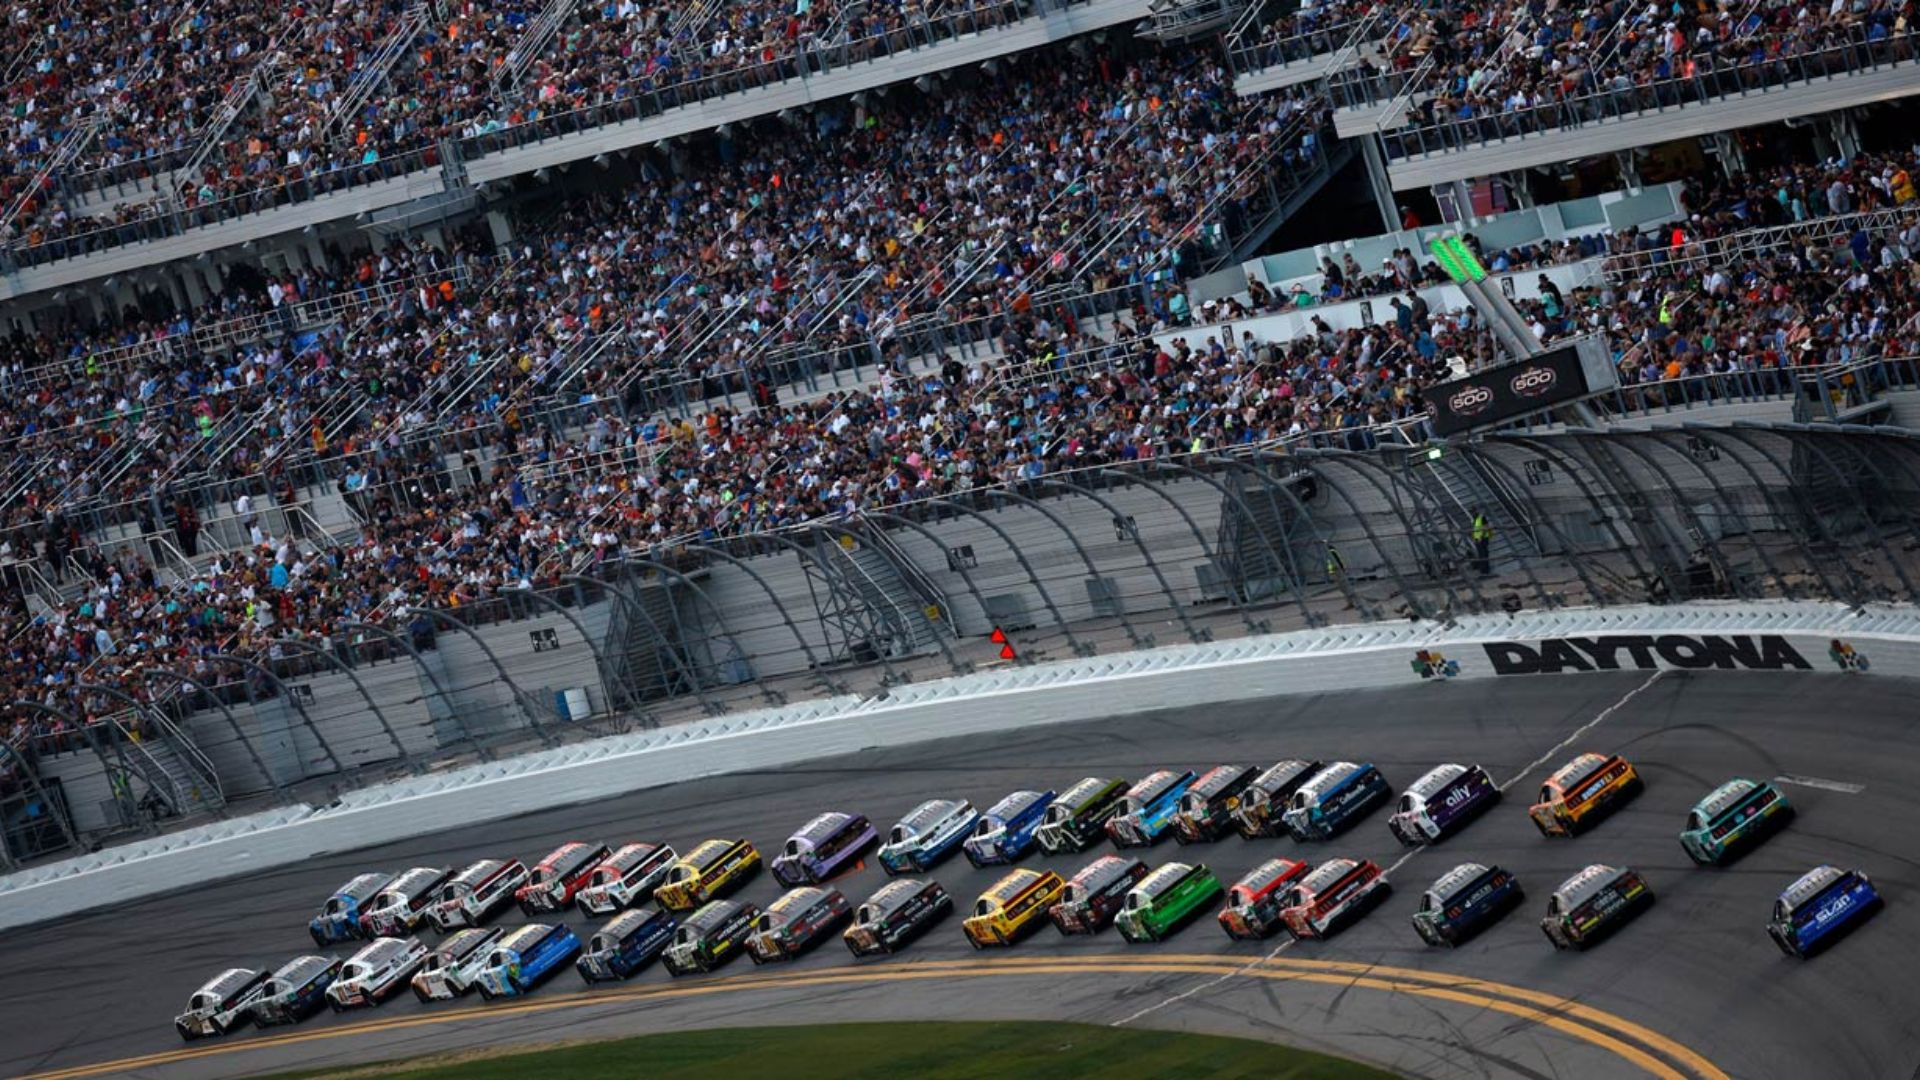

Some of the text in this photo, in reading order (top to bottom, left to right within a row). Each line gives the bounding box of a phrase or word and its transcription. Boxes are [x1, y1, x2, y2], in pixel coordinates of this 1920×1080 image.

[1515, 372, 1551, 390] 500
[1453, 390, 1488, 409] 500
[1482, 634, 1813, 675] DAYTONA
[1445, 784, 1470, 807] ally
